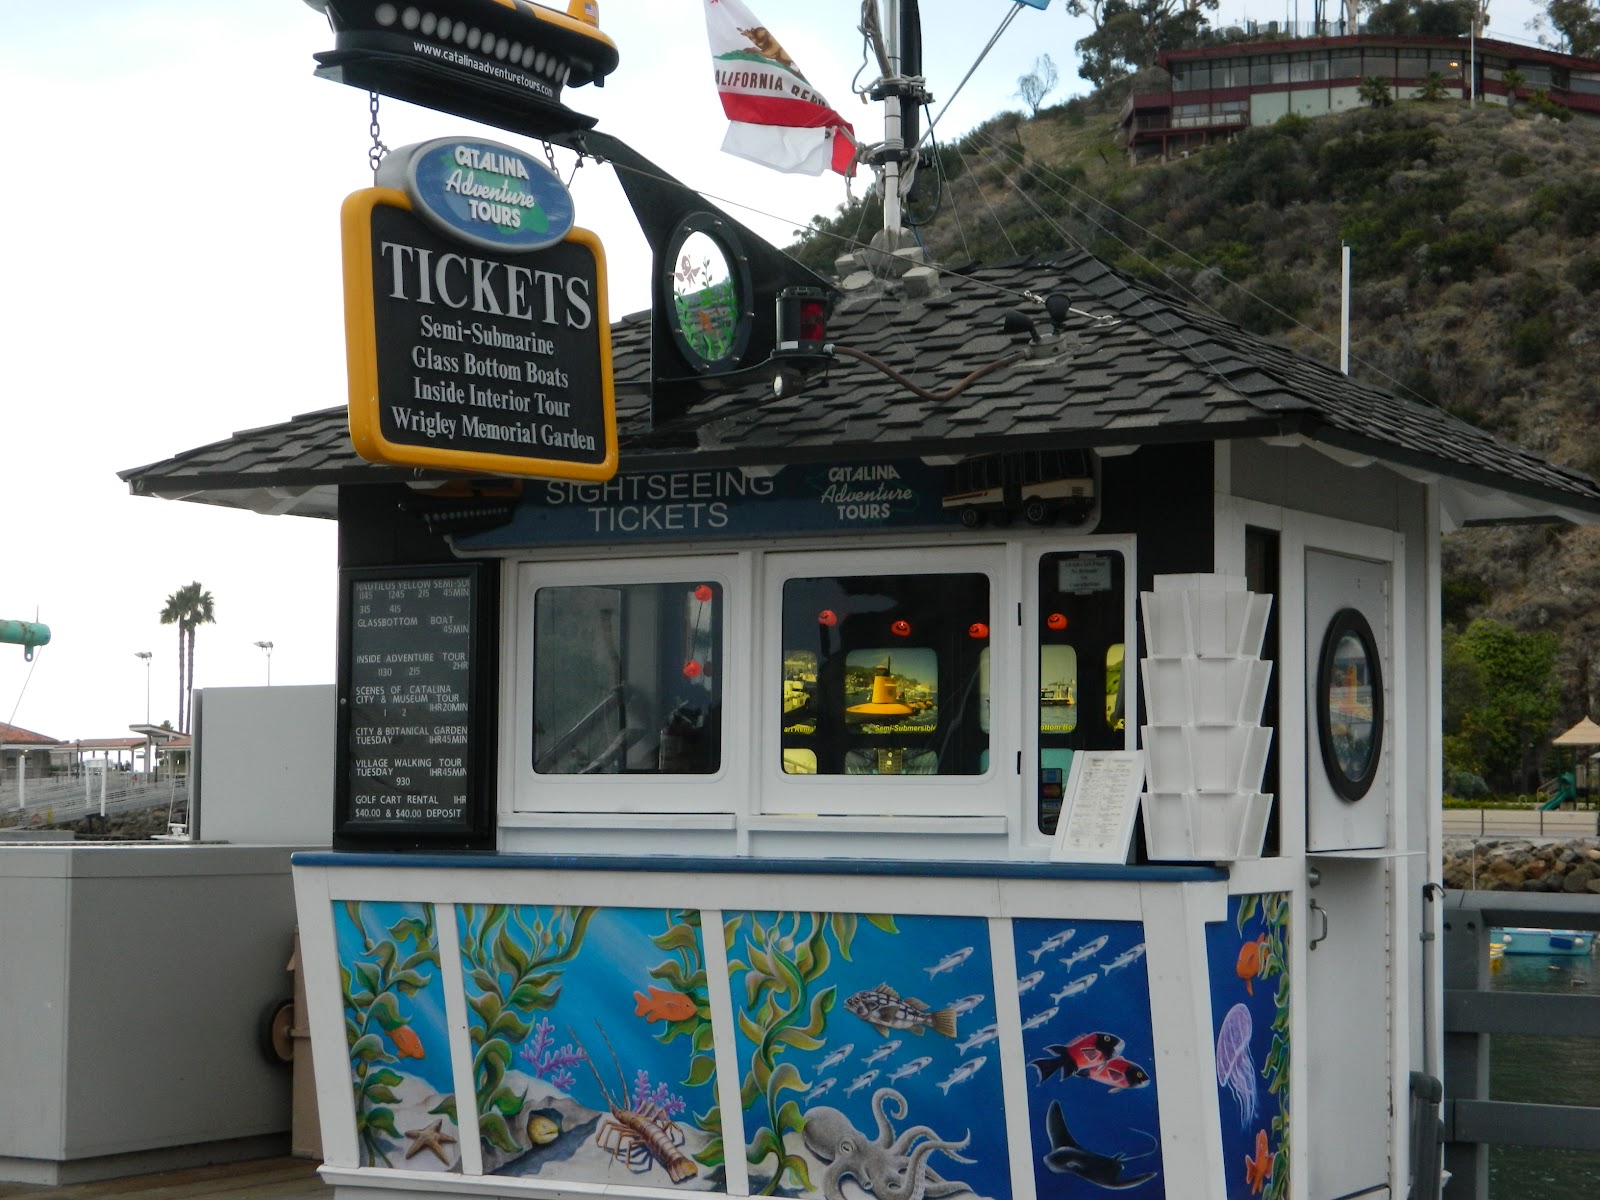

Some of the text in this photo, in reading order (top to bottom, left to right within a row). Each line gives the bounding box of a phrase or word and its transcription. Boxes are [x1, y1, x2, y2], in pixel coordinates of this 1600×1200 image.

[413, 41, 553, 98] www.catalinaadventuretours.com
[715, 69, 783, 91] ALIFORNIA
[455, 145, 530, 180] CATALINA
[446, 169, 534, 208] Adventure
[469, 199, 521, 228] TOURS
[381, 241, 591, 330] TICKETS
[421, 314, 554, 355] Semi-Submarine
[412, 345, 569, 388] Glass Bottom Boats
[413, 376, 571, 418] Inside Interior Tour
[391, 406, 596, 451] Wrigley Memorial Garden
[828, 465, 900, 482] CATALINA
[546, 472, 774, 504] SIGHTSEEING
[821, 482, 912, 503] Adventure
[588, 502, 728, 532] TICKETS
[837, 503, 890, 520] TOURS
[398, 580, 431, 590] YELLOW
[388, 590, 405, 598] 1245
[389, 604, 401, 613] 415
[430, 616, 454, 625] BOAT
[356, 652, 466, 663] INSIDE ADVENTURE TOUR
[356, 685, 452, 695] SCENES OF CATALINA
[355, 694, 460, 704] CITY & MUSEUM TOUR
[355, 727, 375, 736] CITY
[376, 727, 383, 736] &
[434, 725, 468, 735] GARDEN
[356, 736, 393, 745] TUESDAY
[355, 758, 462, 768] VILLAGE WALKING TOUR
[356, 768, 393, 777] TUESDAY
[396, 777, 411, 786] 930
[355, 795, 376, 804] GOLF
[380, 795, 402, 804] CART
[407, 795, 439, 804] RENTAL
[355, 808, 462, 818] $40.00 & $40.00 DEPOSIT
